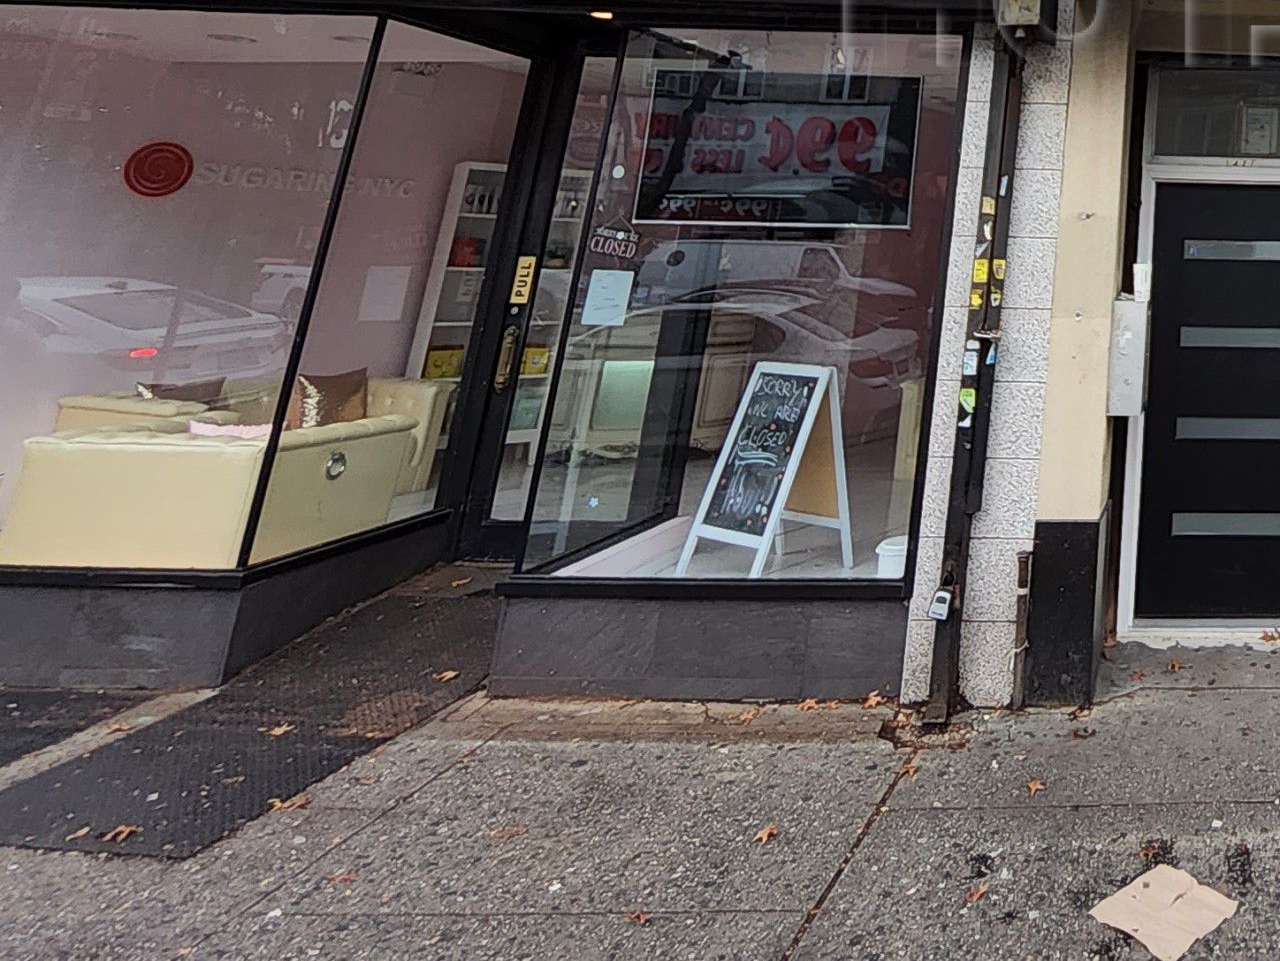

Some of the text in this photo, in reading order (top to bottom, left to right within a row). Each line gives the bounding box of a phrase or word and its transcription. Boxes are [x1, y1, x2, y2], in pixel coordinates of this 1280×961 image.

[195, 162, 354, 194] SUGARIN
[590, 236, 637, 258] CLOSED
[515, 262, 532, 297] PULL
[738, 424, 788, 448] CLOSED
